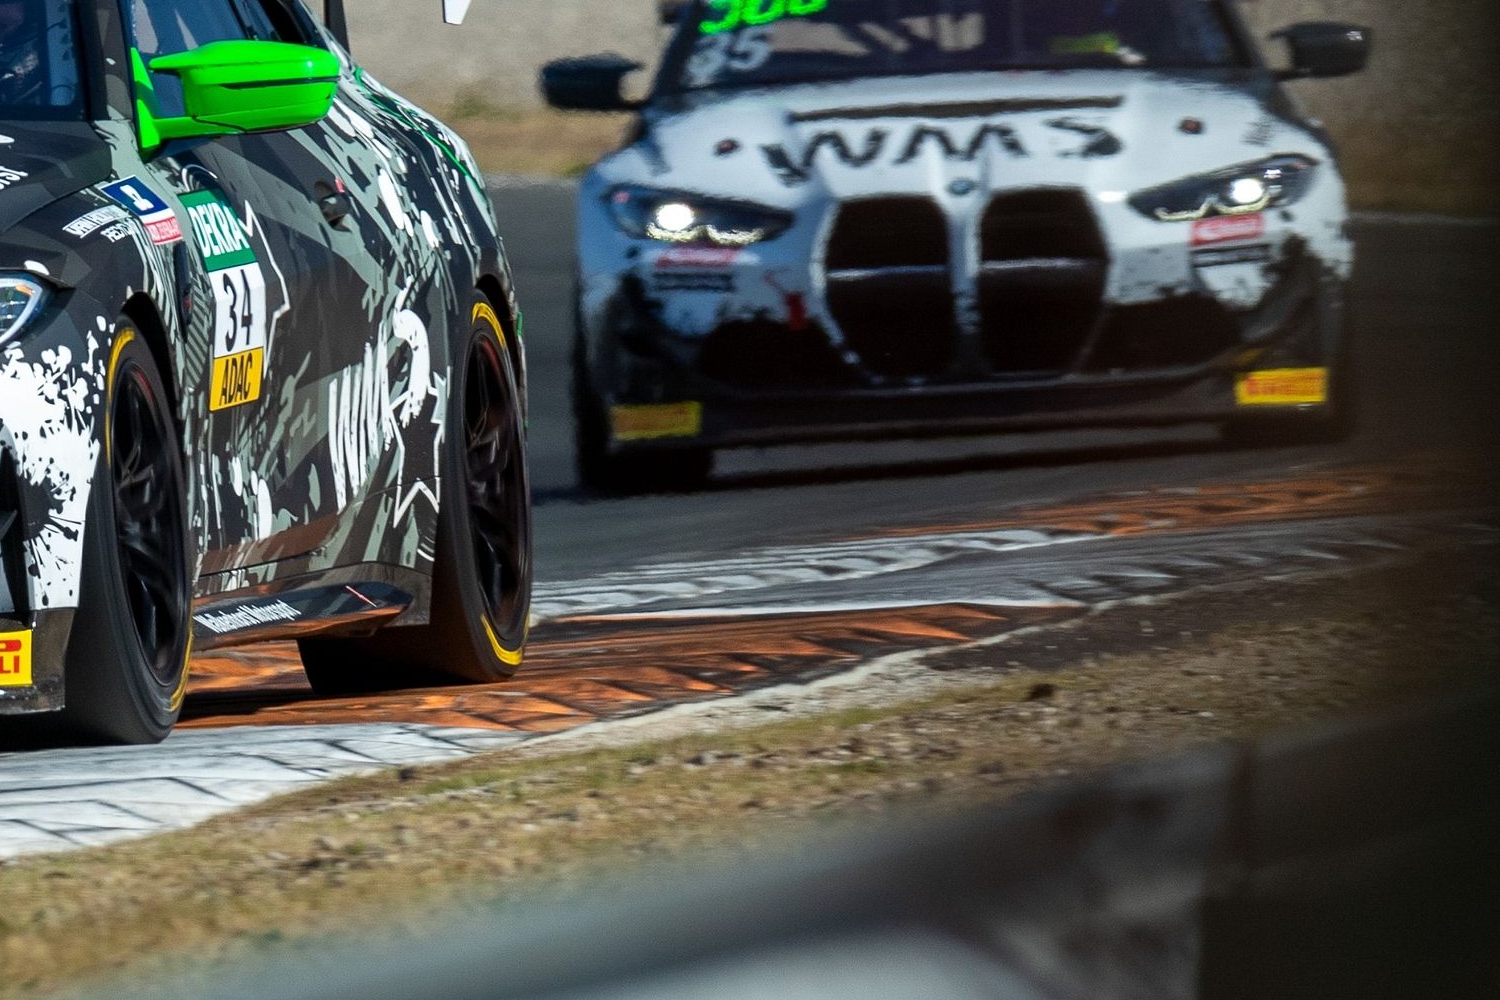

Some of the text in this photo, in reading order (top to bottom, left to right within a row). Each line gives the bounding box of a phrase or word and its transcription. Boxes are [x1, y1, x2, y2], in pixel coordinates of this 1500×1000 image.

[759, 117, 1123, 187] WMS
[188, 202, 250, 258] DEKRA
[222, 268, 253, 352] 34
[219, 352, 253, 406] ADAC
